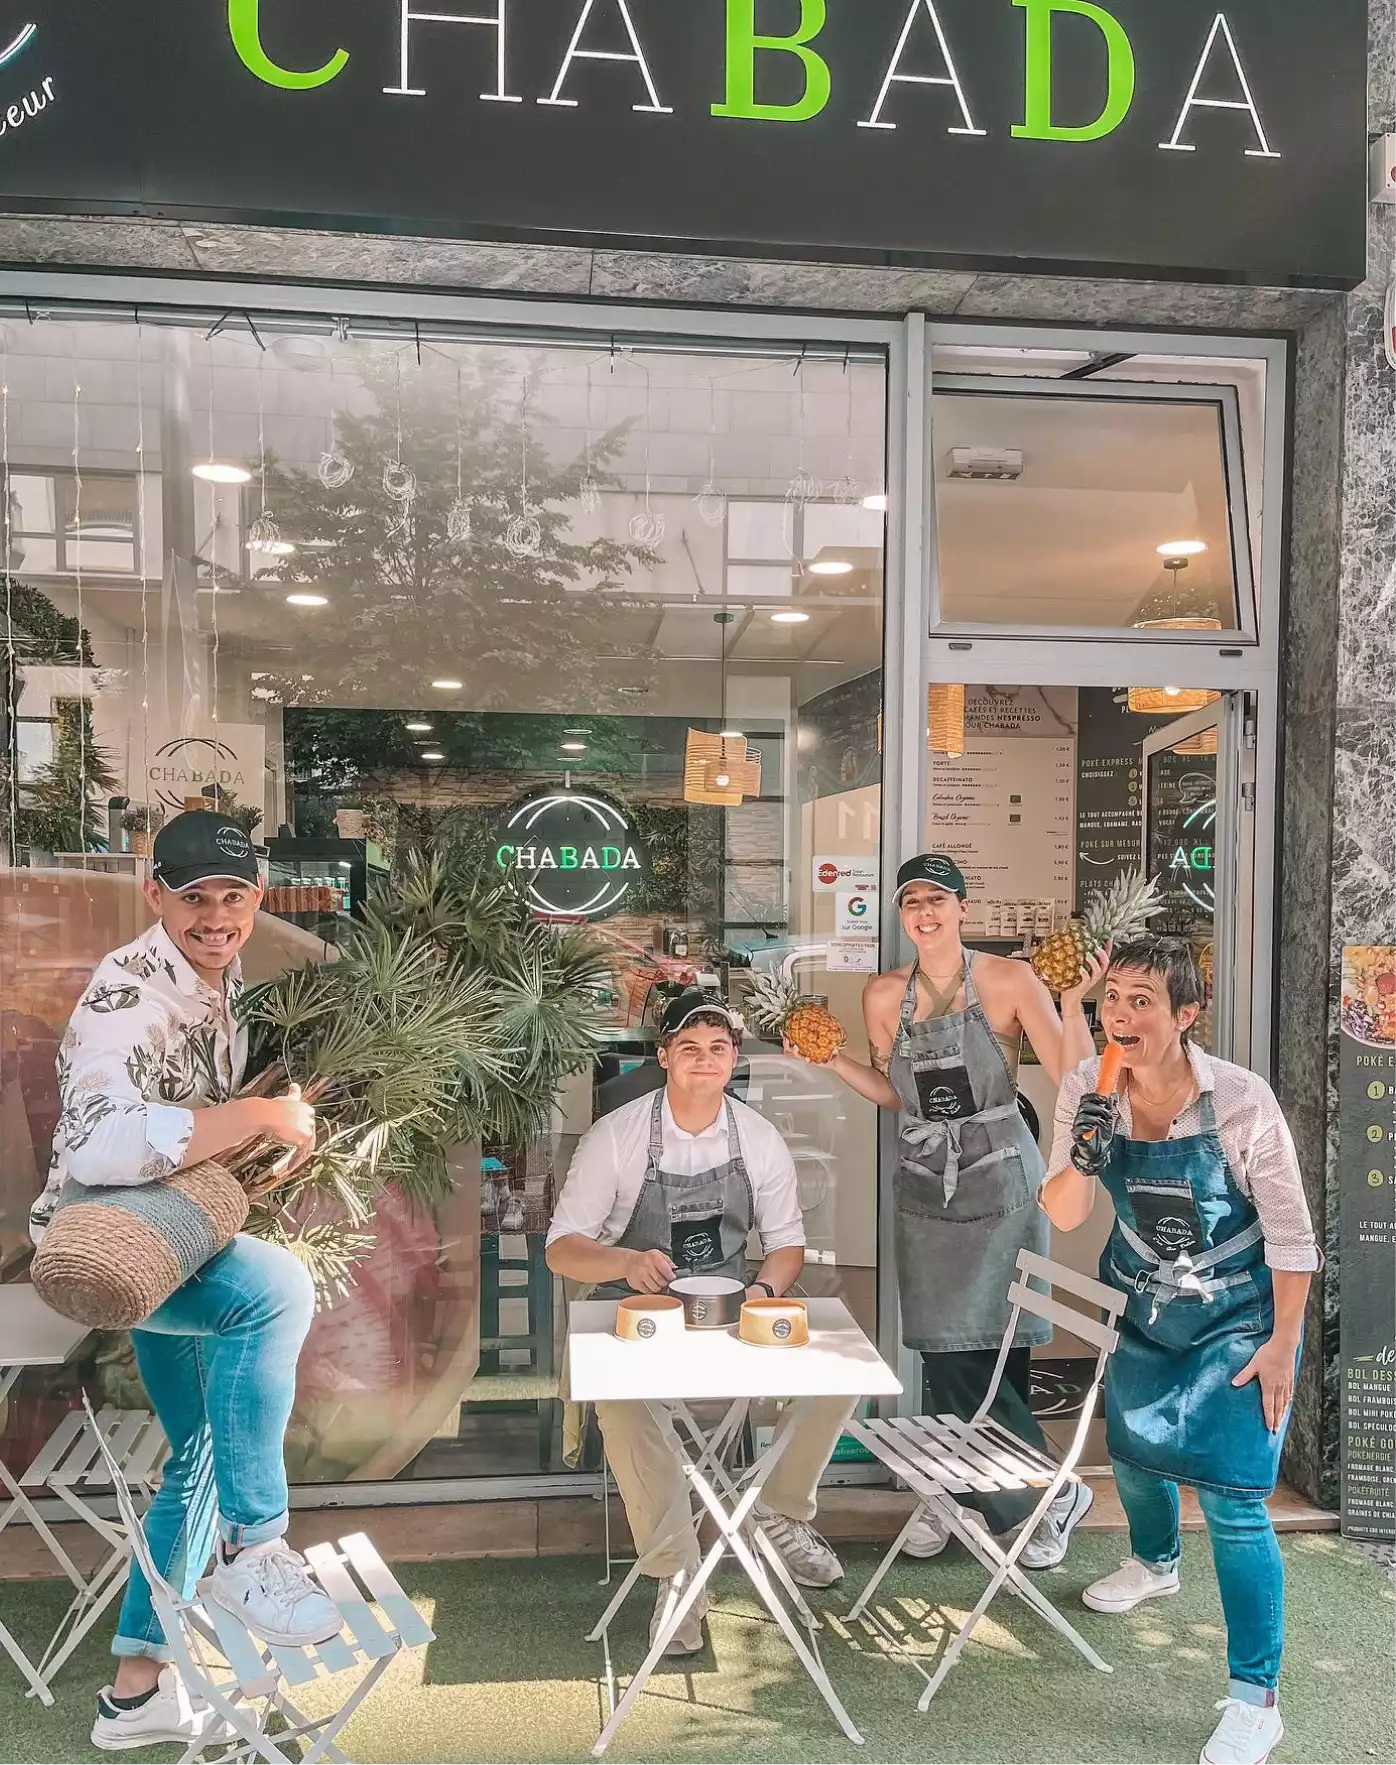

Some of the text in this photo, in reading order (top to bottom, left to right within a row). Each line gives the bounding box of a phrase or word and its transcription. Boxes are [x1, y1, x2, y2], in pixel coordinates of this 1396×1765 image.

[228, 0, 1281, 157] CHABADA
[1102, 757, 1134, 767] EXPRESS
[150, 767, 245, 785] CHABADA
[215, 838, 250, 849] CHABADA
[496, 845, 642, 870] CHABADA
[818, 869, 852, 877] Edenred
[1356, 1053, 1384, 1067] POKÉ
[1155, 1225, 1194, 1236] CHABADA
[1359, 1221, 1368, 1229] LE
[1369, 1221, 1388, 1230] TOUT
[1347, 1368, 1368, 1380] BOL
[1347, 1381, 1391, 1392] BOL MANGUE
[1347, 1394, 1361, 1403] BOL
[1347, 1407, 1361, 1416] BOL
[1363, 1408, 1379, 1417] MINI
[1347, 1420, 1361, 1430] BOL
[1347, 1435, 1376, 1449] POKÉ
